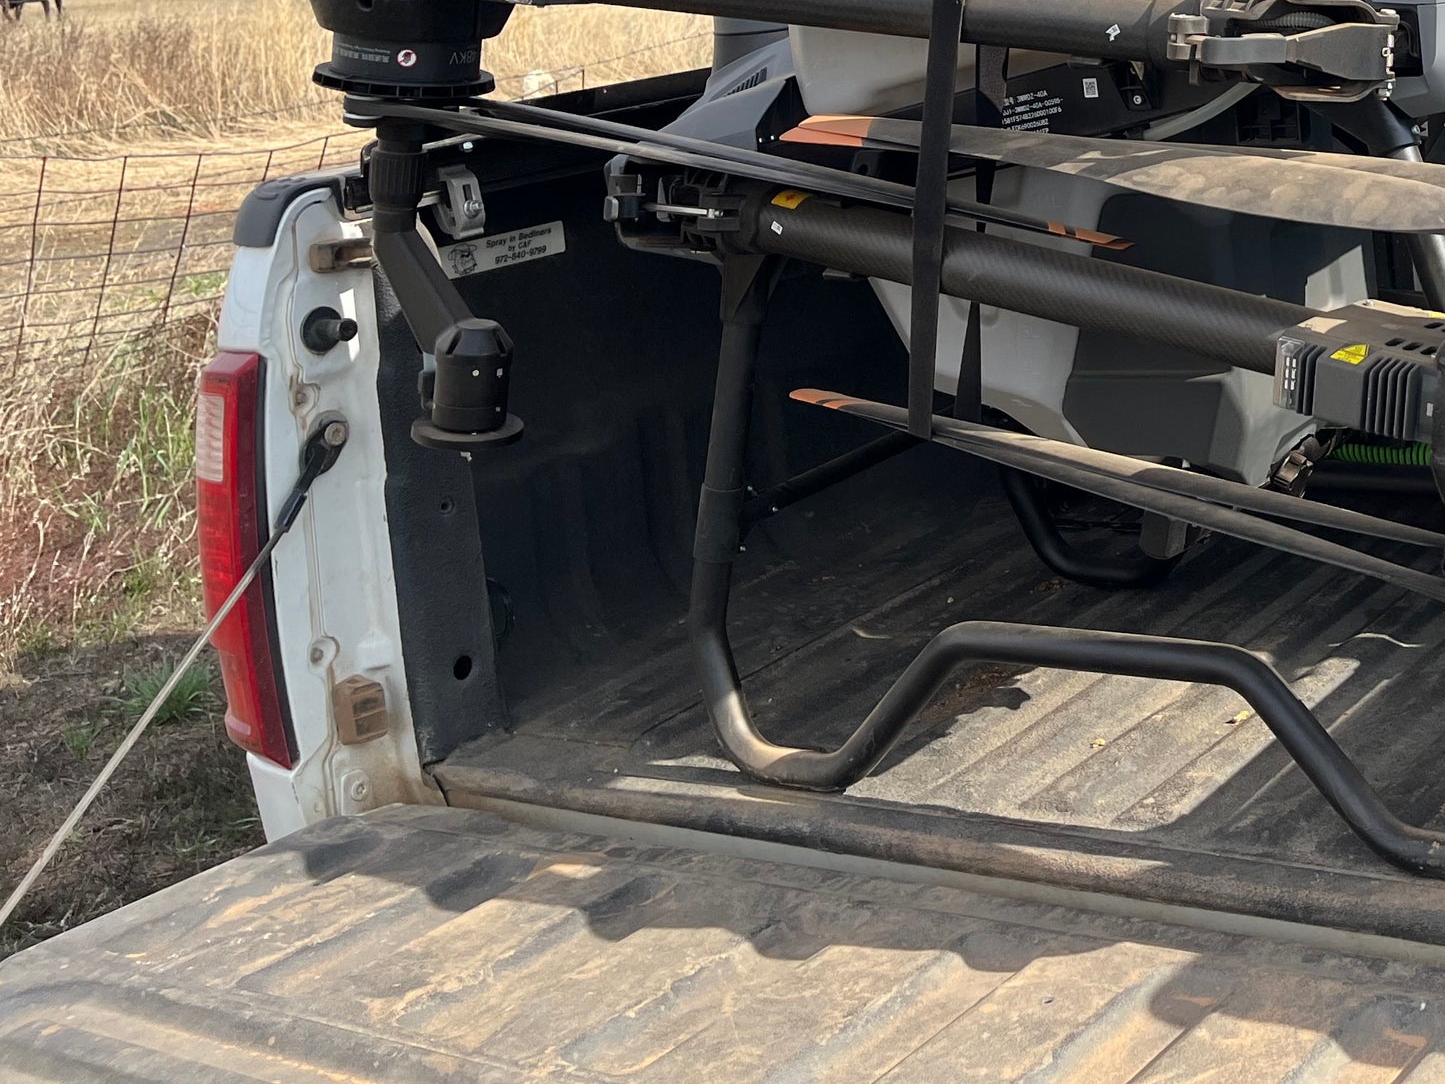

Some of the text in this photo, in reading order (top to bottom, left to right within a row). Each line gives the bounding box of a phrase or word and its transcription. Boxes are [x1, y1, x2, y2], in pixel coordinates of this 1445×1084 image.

[486, 228, 552, 249] Spray in Bedliners
